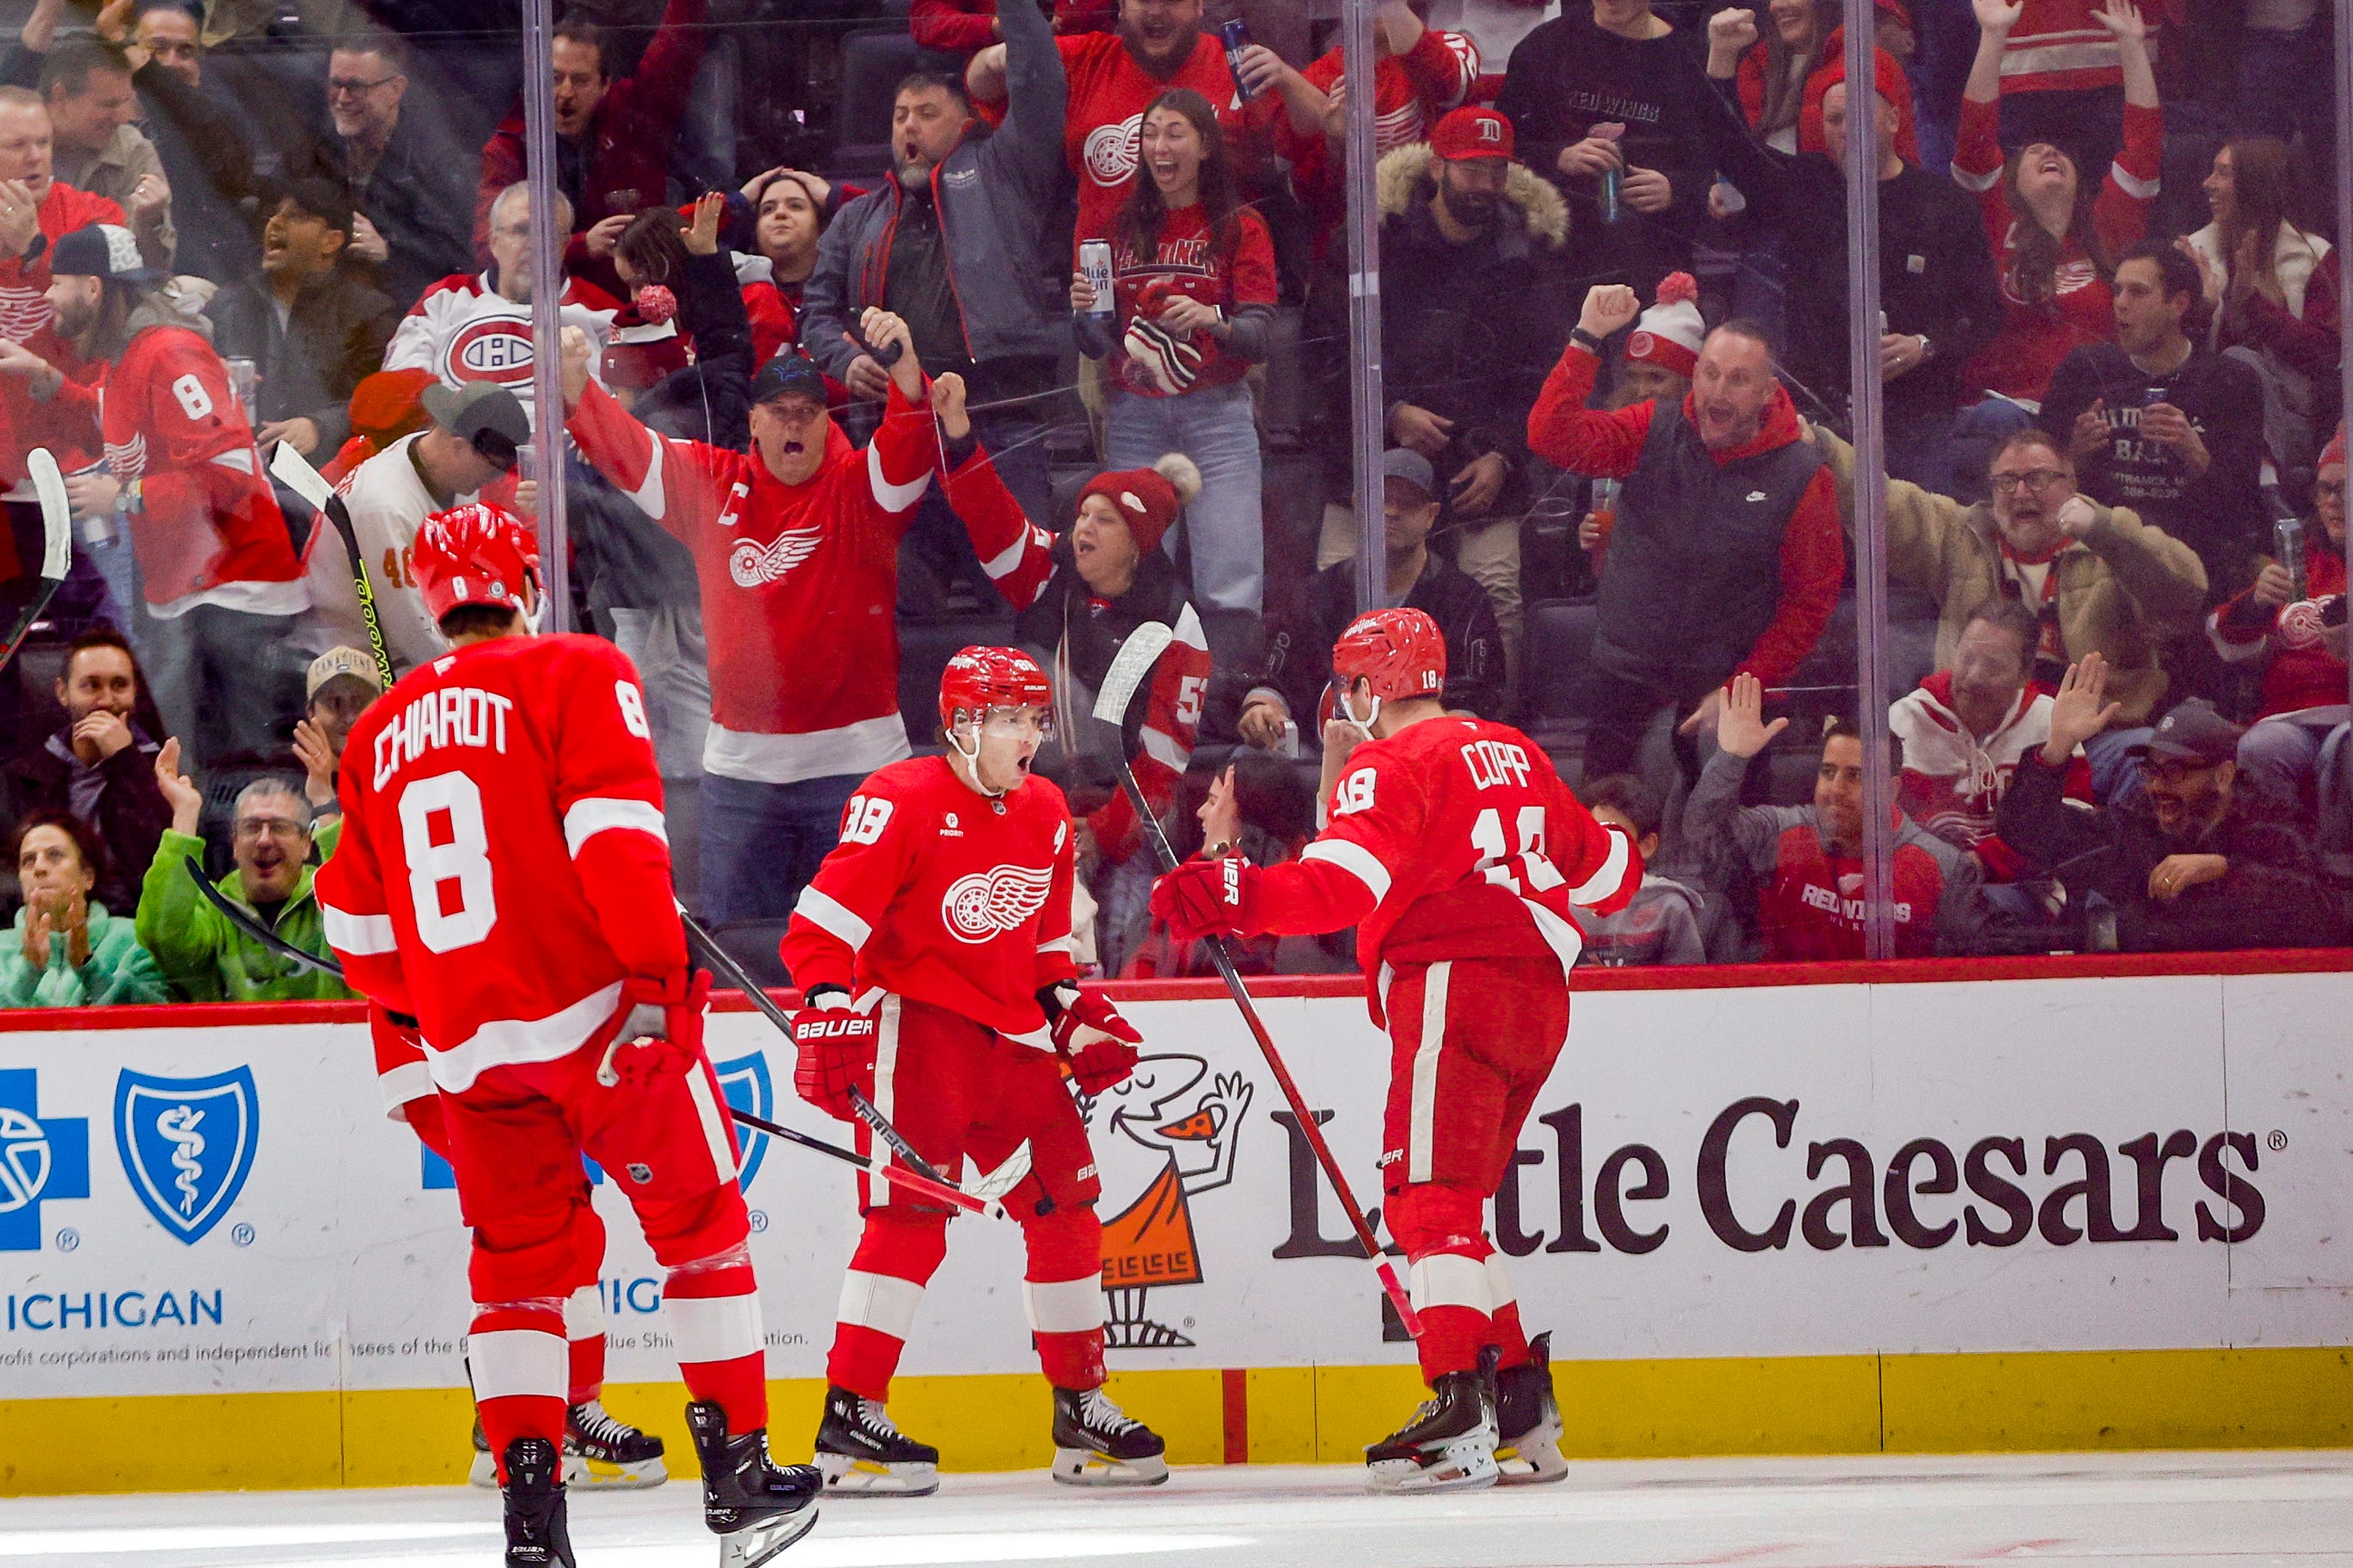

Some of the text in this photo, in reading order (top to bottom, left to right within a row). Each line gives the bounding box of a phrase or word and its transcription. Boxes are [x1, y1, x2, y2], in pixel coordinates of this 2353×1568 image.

[173, 374, 212, 420] 8
[718, 482, 749, 526] C
[452, 576, 468, 600] 8
[1422, 670, 1437, 689] 18
[614, 680, 651, 739] 8
[372, 686, 513, 792] CHIAROT
[1461, 740, 1531, 790] COPP
[1333, 767, 1377, 818] 18
[398, 770, 498, 955] 8
[1696, 1096, 2266, 1253] Caesars
[40, 1346, 150, 1369] corporations
[156, 1344, 190, 1362] and
[196, 1340, 309, 1366] independent
[401, 1337, 419, 1355] of
[425, 1336, 453, 1354] the
